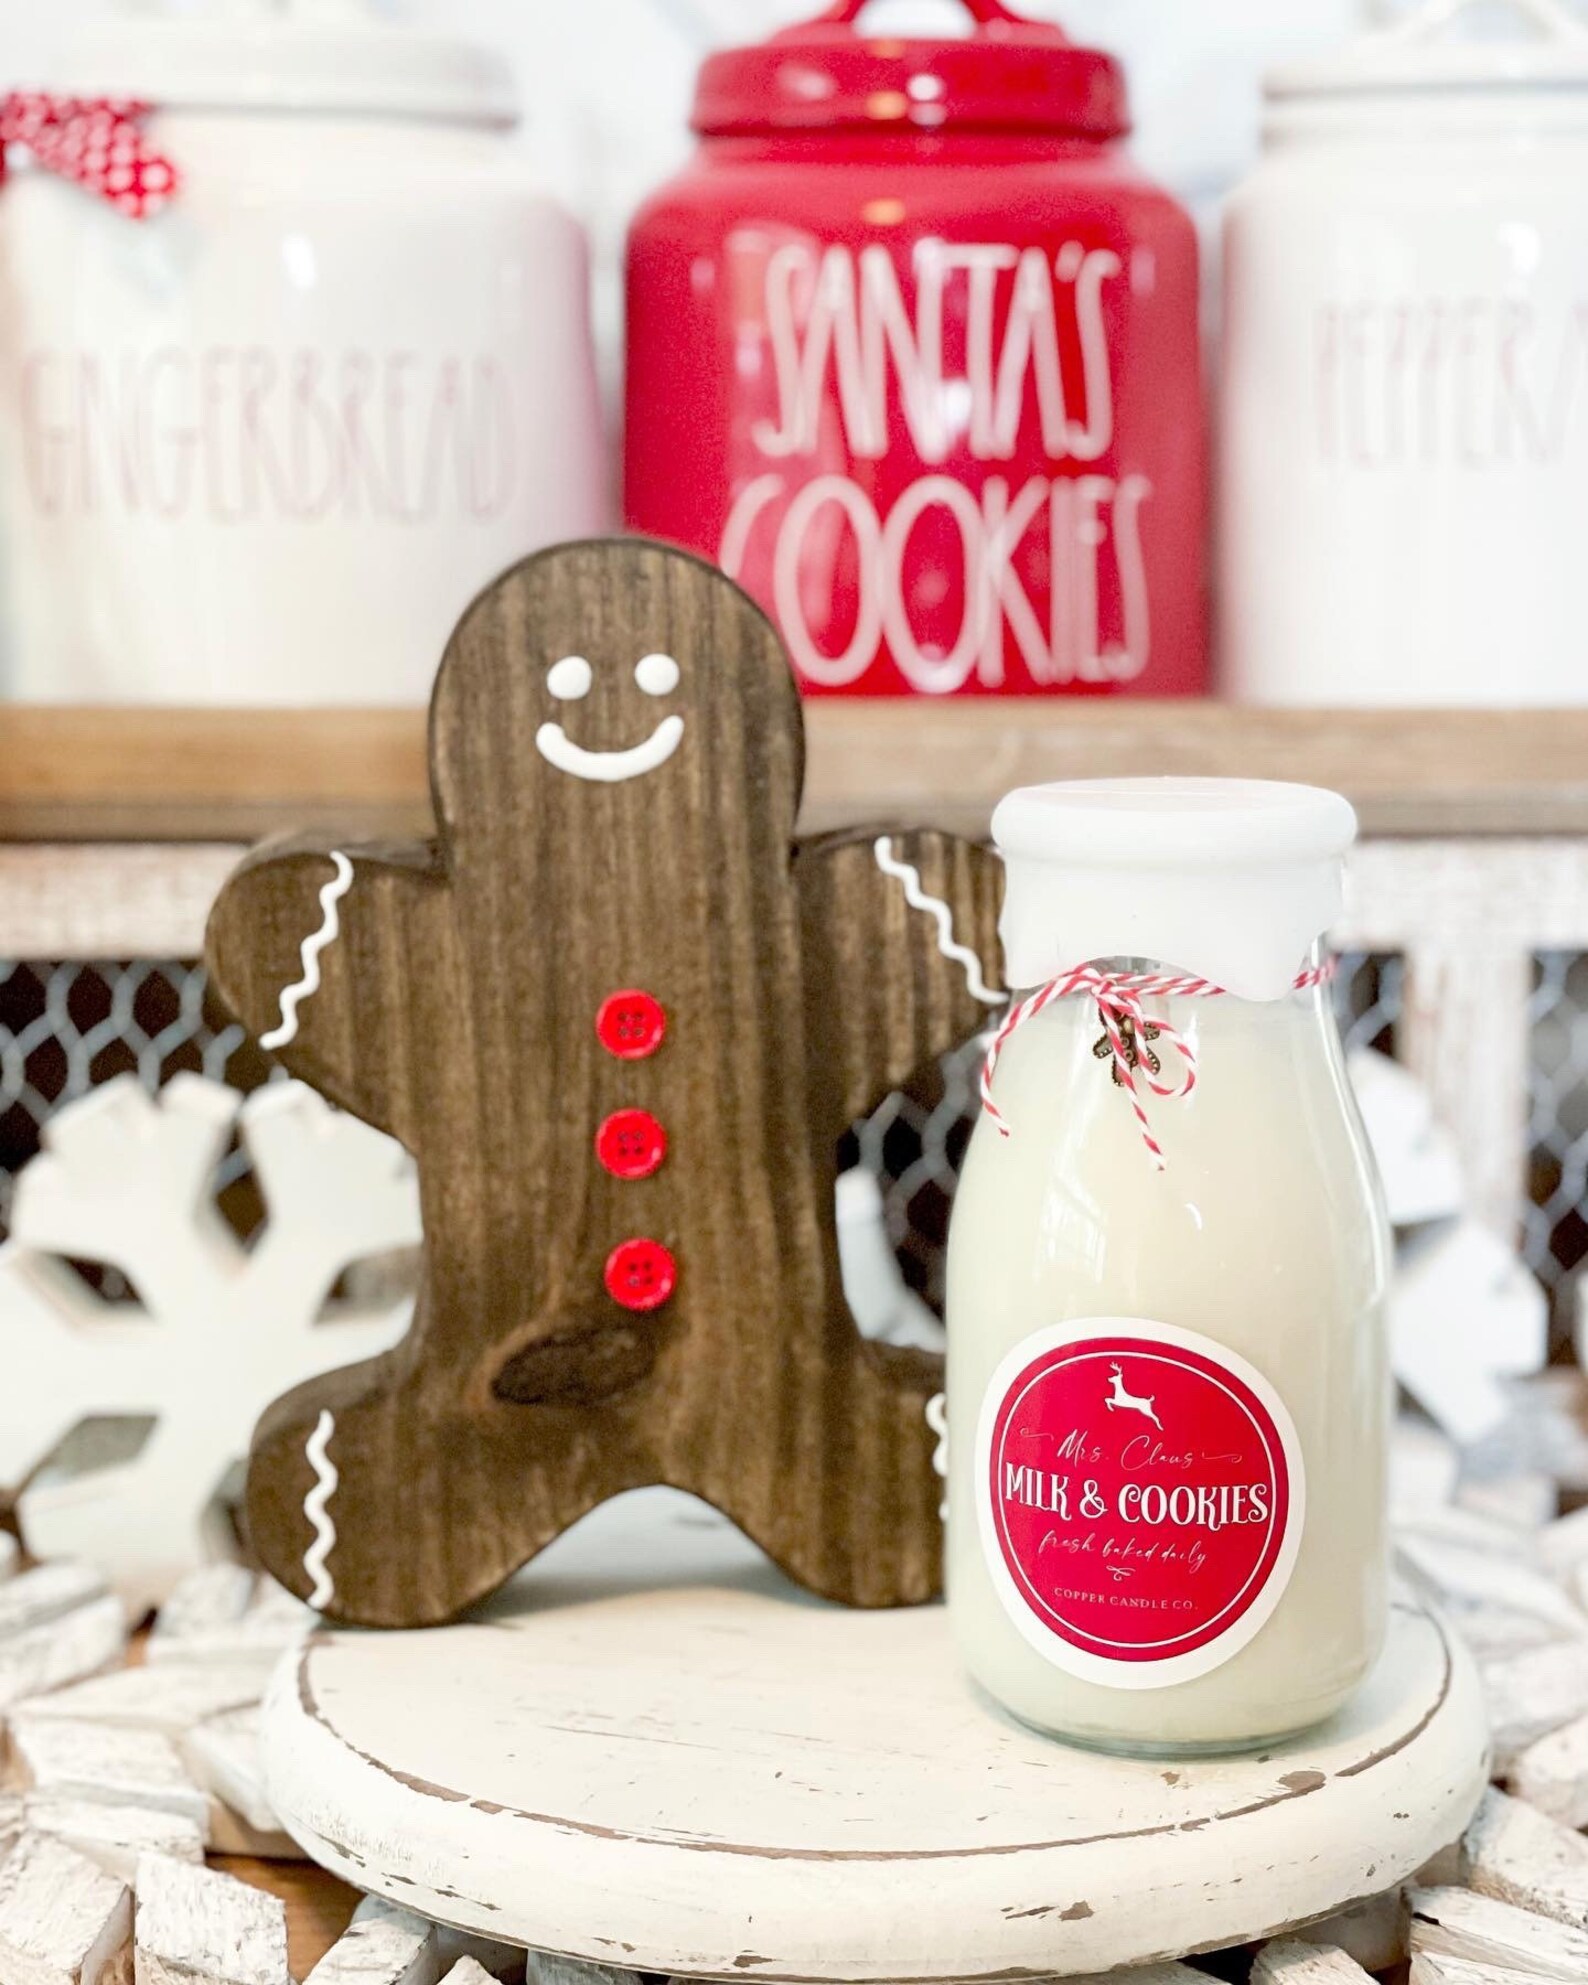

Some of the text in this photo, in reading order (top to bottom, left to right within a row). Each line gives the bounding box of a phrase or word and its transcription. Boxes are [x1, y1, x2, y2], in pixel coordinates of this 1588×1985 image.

[752, 240, 1121, 463] SANTA'S
[1057, 1429, 1194, 1471] Mrs. Claus
[1005, 1461, 1269, 1531] MILK & COOKIES
[1038, 1529, 1208, 1575] fresh baked daily
[1054, 1587, 1200, 1611] COPPER CANDLE CO.
